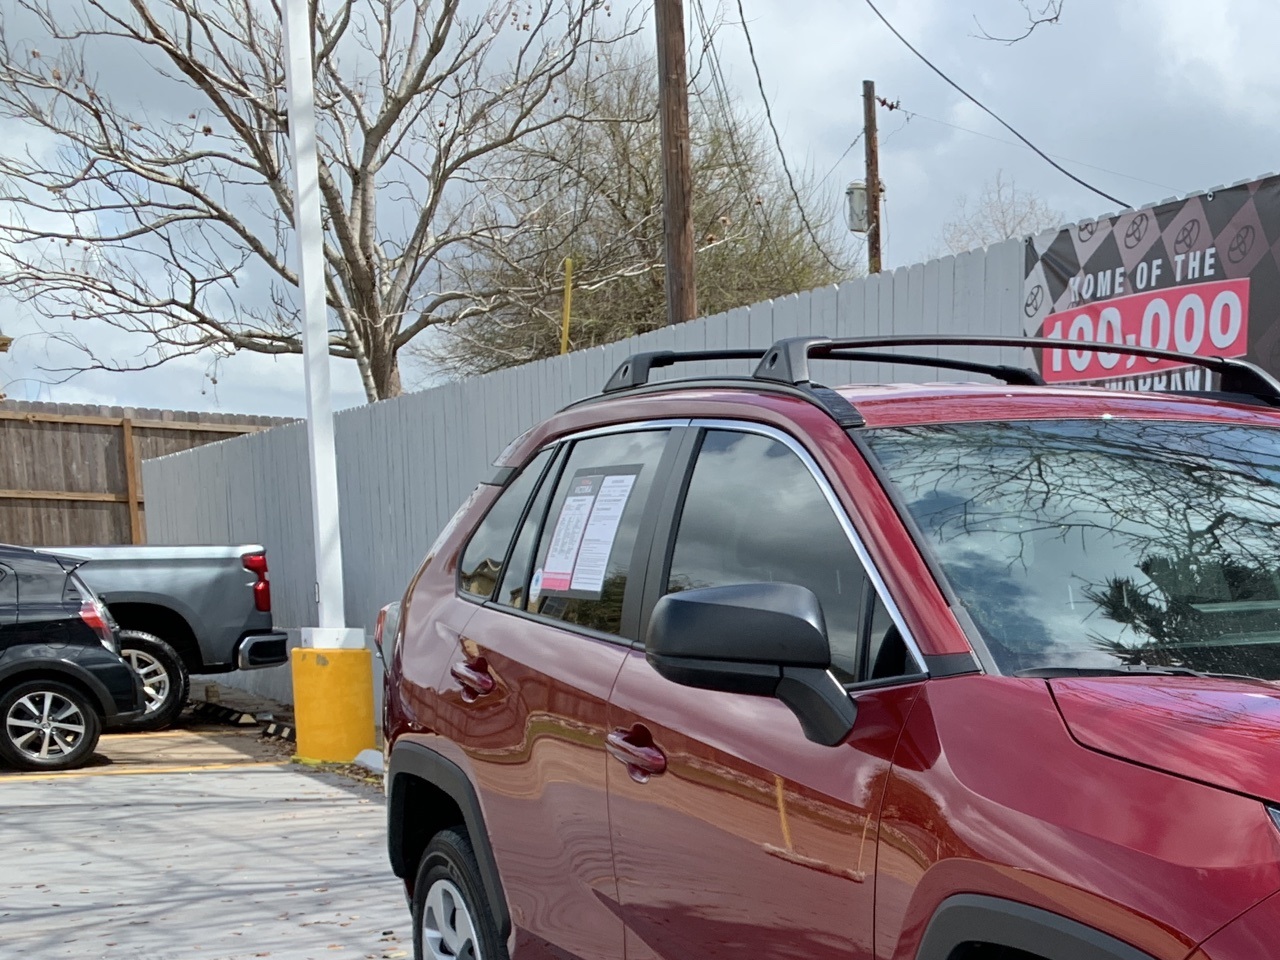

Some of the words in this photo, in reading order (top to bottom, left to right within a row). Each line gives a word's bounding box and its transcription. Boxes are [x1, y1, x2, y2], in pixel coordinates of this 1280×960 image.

[1070, 267, 1125, 301] HOME
[1136, 259, 1162, 290] OF
[1174, 247, 1217, 284] THE
[1048, 290, 1242, 371] 100,000
